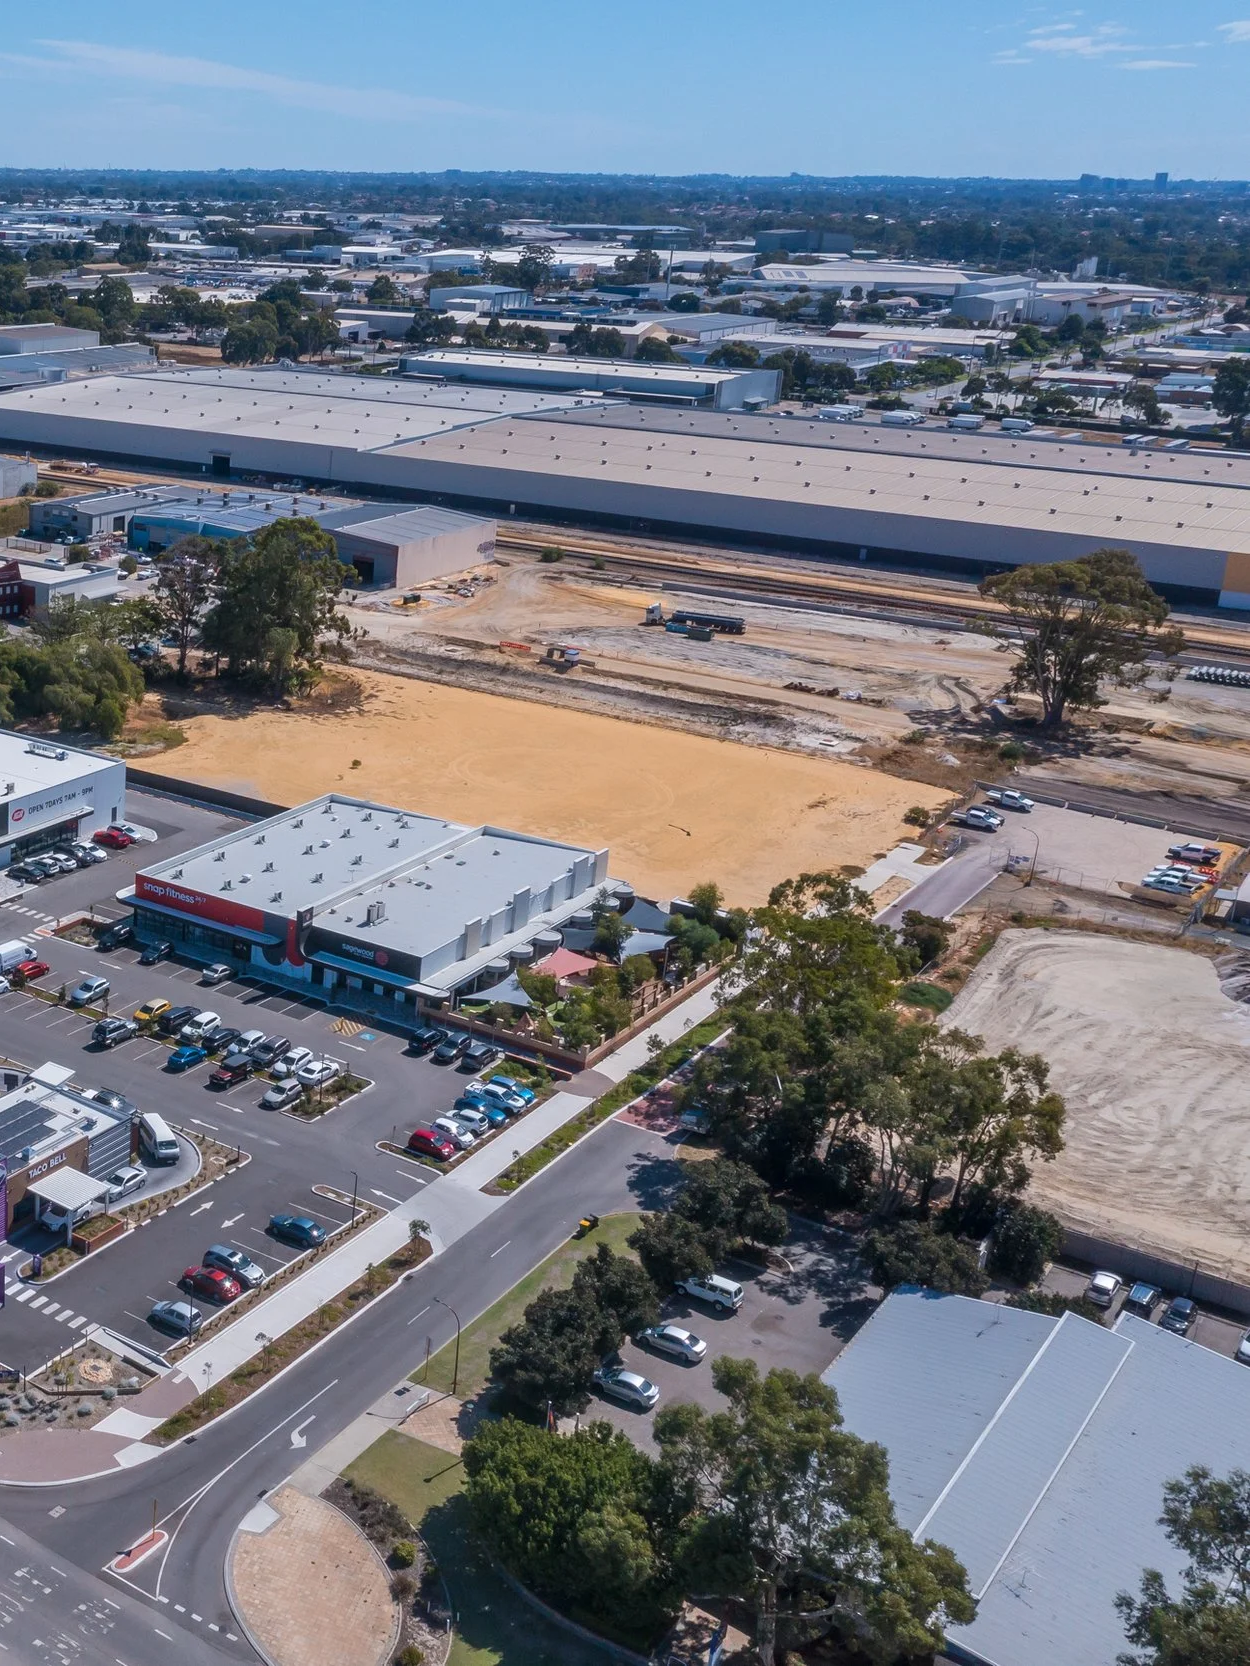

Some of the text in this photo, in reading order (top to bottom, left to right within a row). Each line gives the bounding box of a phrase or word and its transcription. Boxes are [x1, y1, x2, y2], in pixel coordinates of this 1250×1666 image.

[28, 802, 44, 815] OPEN
[64, 791, 77, 802] 7AM
[81, 786, 94, 796] 9PM
[143, 882, 165, 896] snap
[165, 887, 195, 904] fitness
[29, 1152, 67, 1179] TACO BELL
